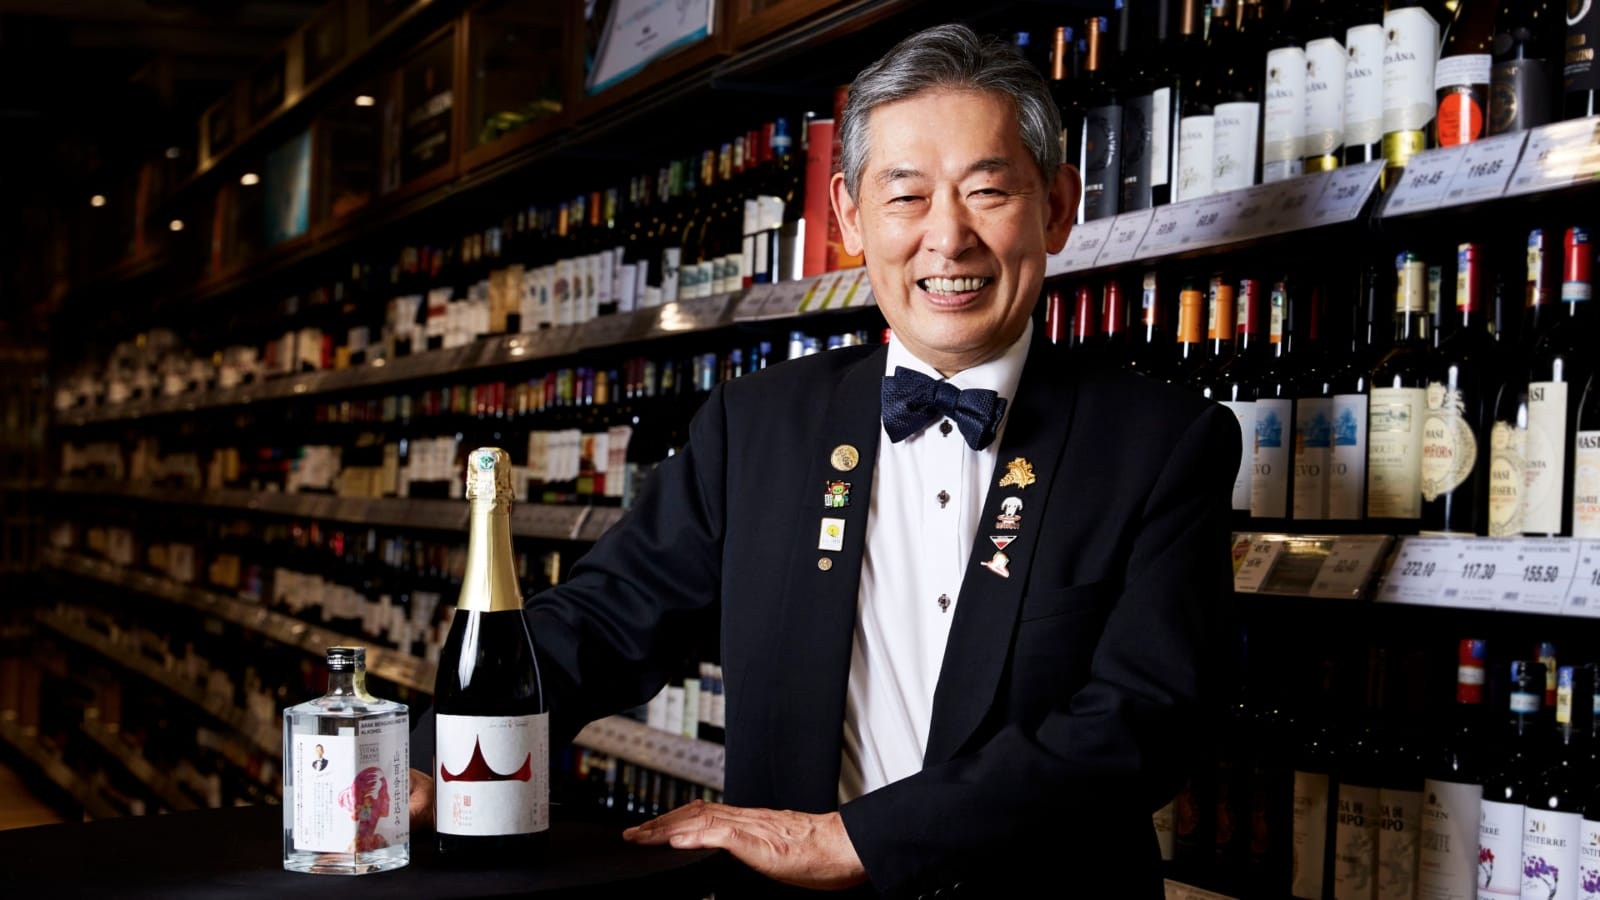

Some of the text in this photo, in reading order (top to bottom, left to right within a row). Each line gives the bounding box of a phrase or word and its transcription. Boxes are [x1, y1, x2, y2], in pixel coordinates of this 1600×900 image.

[1401, 561, 1436, 577] 272.10
[1461, 563, 1496, 580] 117.30
[1522, 565, 1559, 583] 155.50
